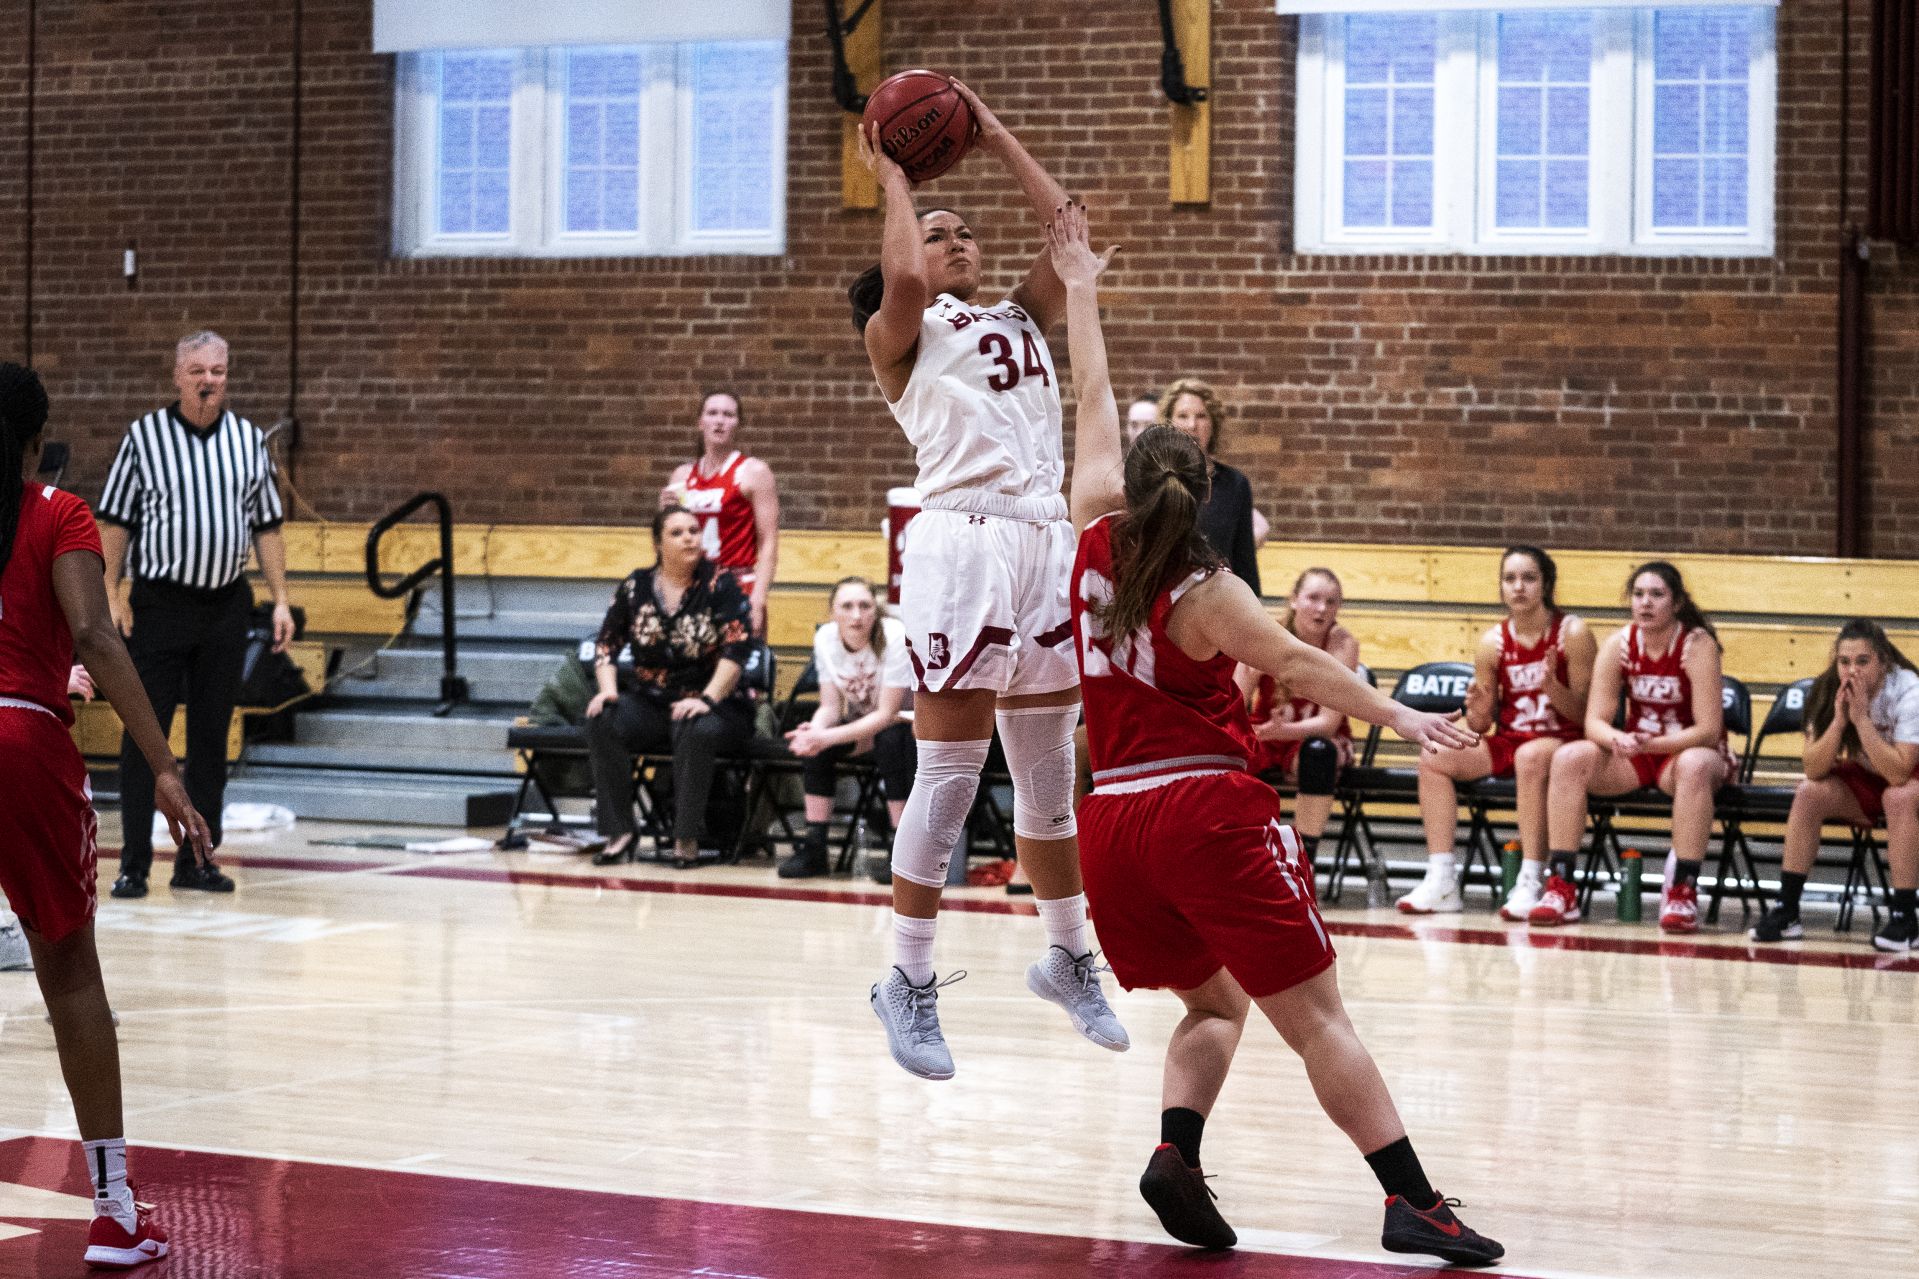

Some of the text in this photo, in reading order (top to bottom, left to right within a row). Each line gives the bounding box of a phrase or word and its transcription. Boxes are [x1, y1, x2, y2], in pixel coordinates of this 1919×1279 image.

[978, 326, 1050, 393] 34
[1405, 673, 1475, 697] BATE
[1629, 674, 1684, 704] WPI
